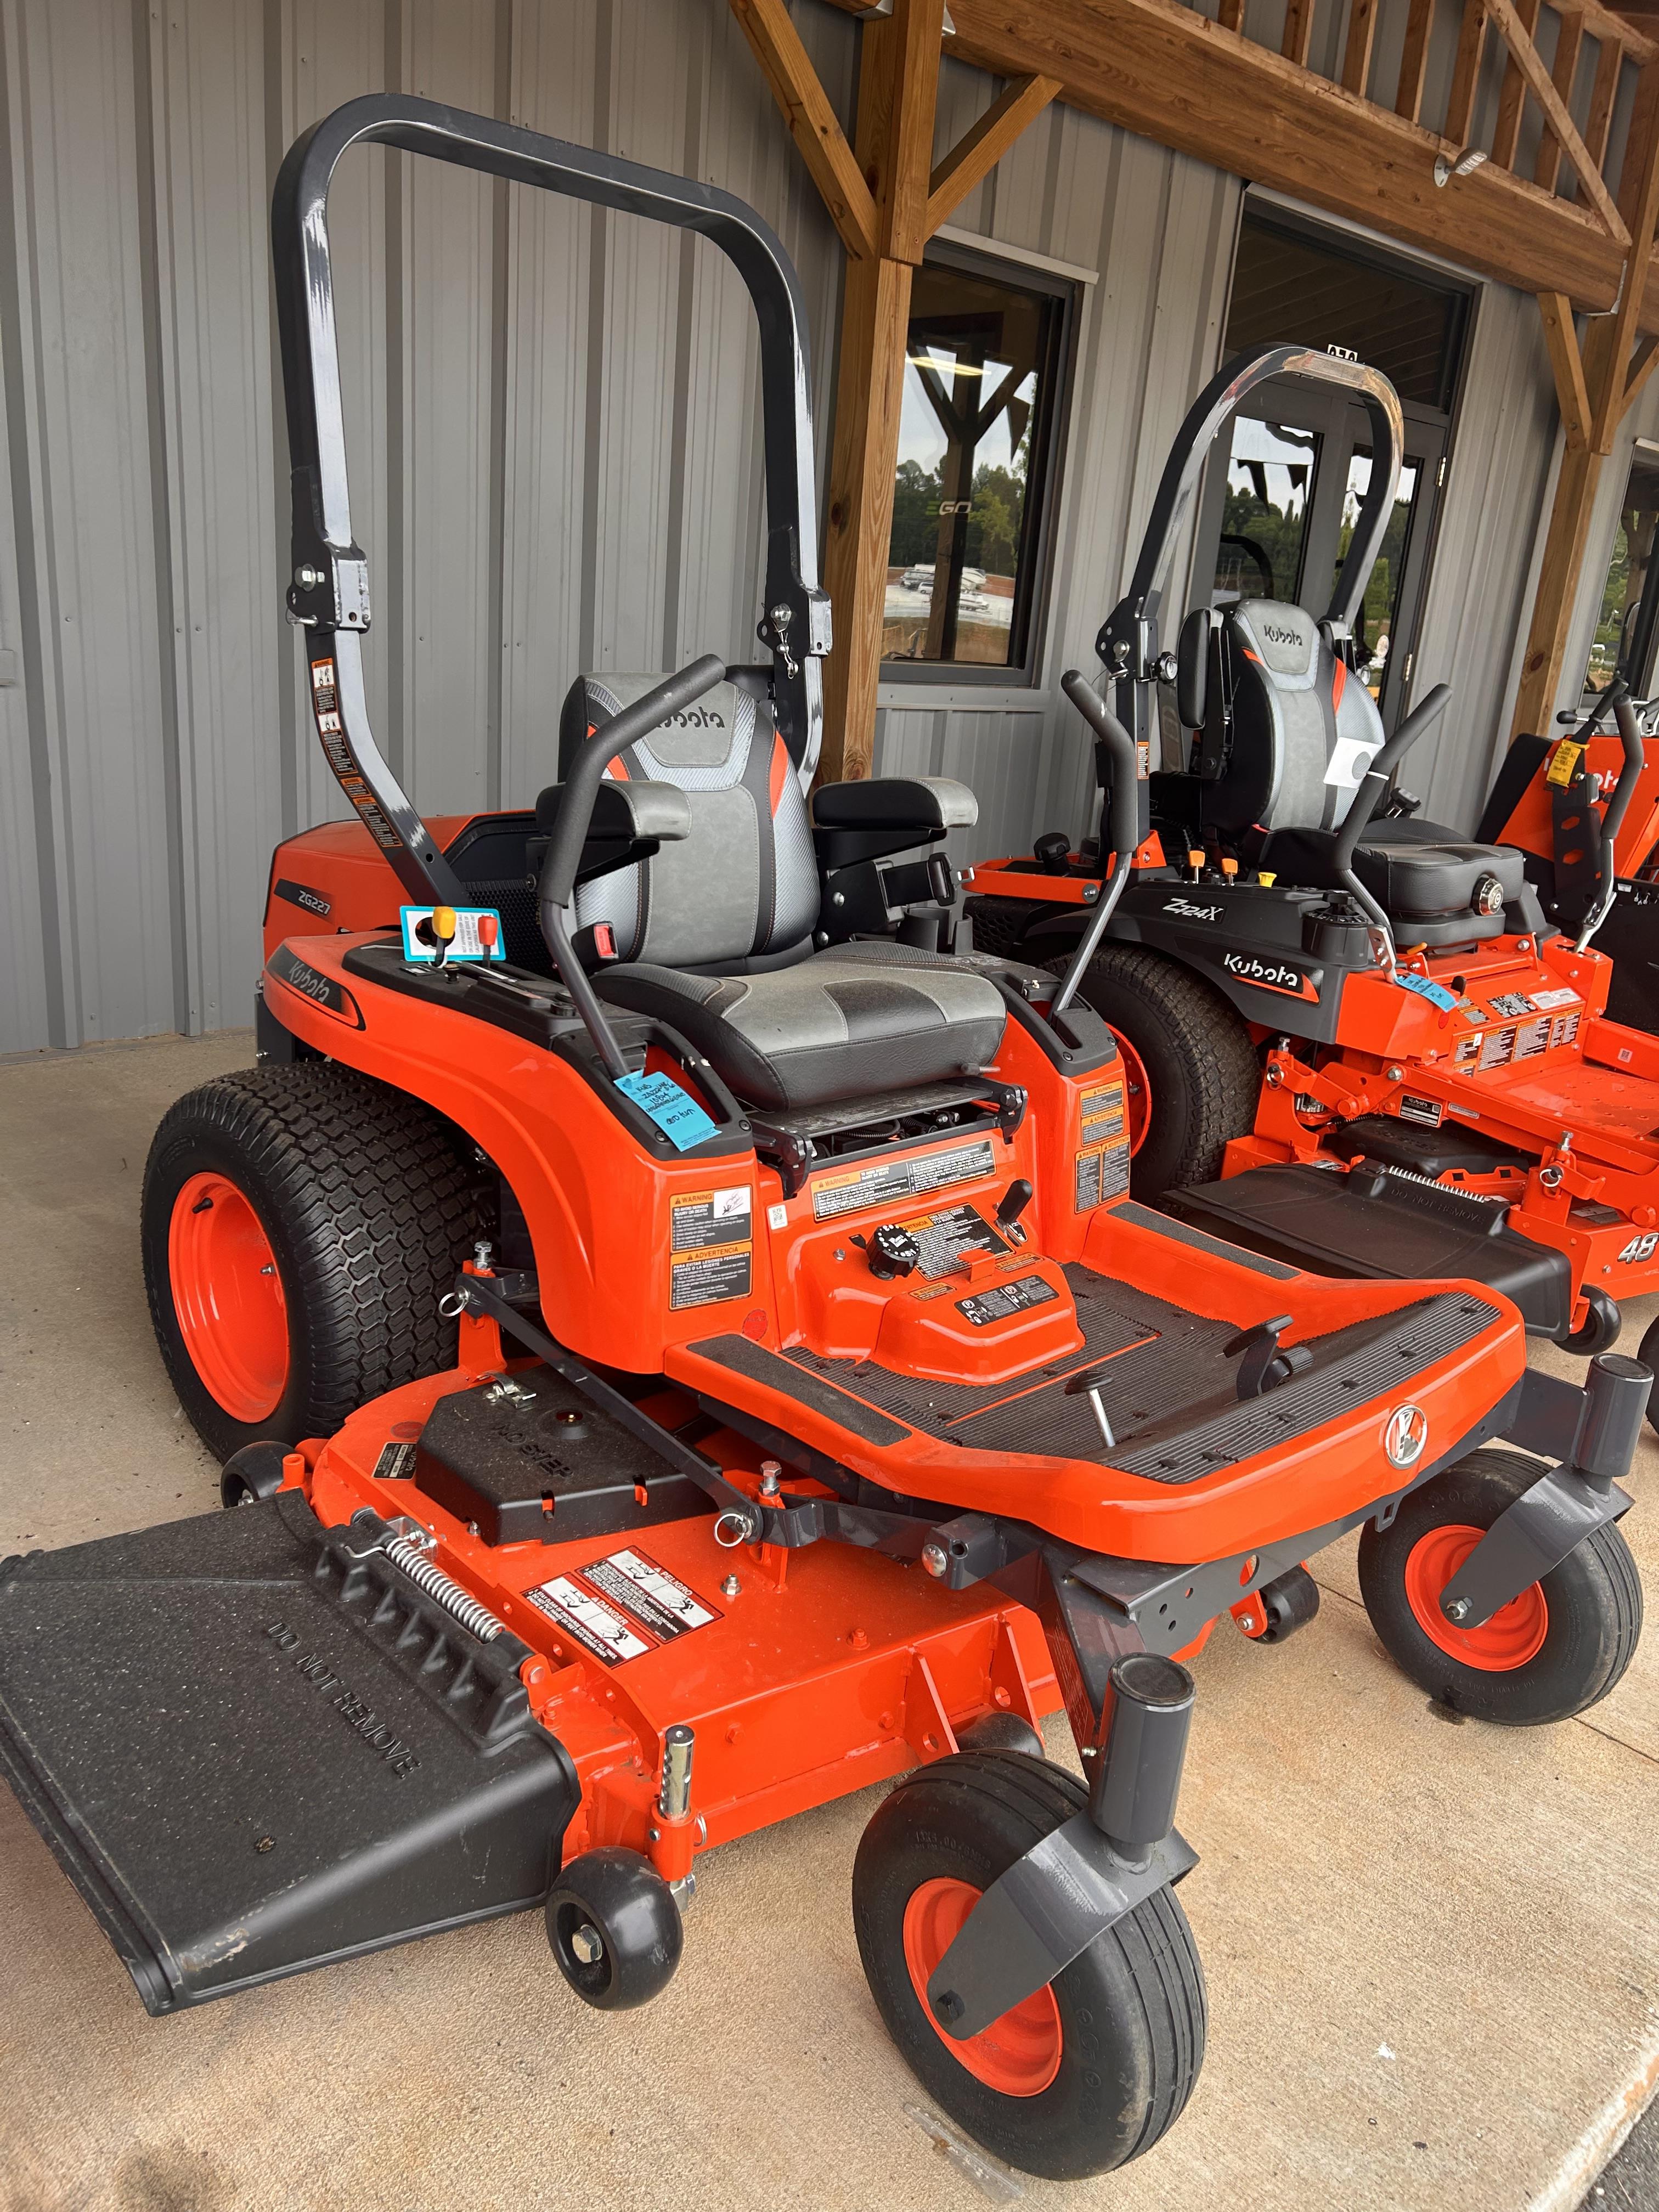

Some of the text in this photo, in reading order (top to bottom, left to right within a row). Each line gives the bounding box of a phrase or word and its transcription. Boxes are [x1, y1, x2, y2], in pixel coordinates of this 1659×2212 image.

[925, 501, 972, 515] EGO
[1263, 624, 1303, 646] Kubota
[298, 890, 331, 915] ZG227
[1162, 898, 1224, 922] Z724X
[1224, 953, 1298, 986] Kubota
[288, 961, 330, 1003] Kubota
[825, 1176, 850, 1186] WARNING
[682, 1193, 713, 1203] WARNING
[905, 1221, 928, 1231] ERTENCIA
[695, 1246, 739, 1259] ADVERTENCIA
[520, 1444, 575, 1479] STEP
[659, 1571, 694, 1596] PELIGRO
[595, 1600, 630, 1626] DANGER
[268, 1622, 422, 1780] DO NOT REMOVE
